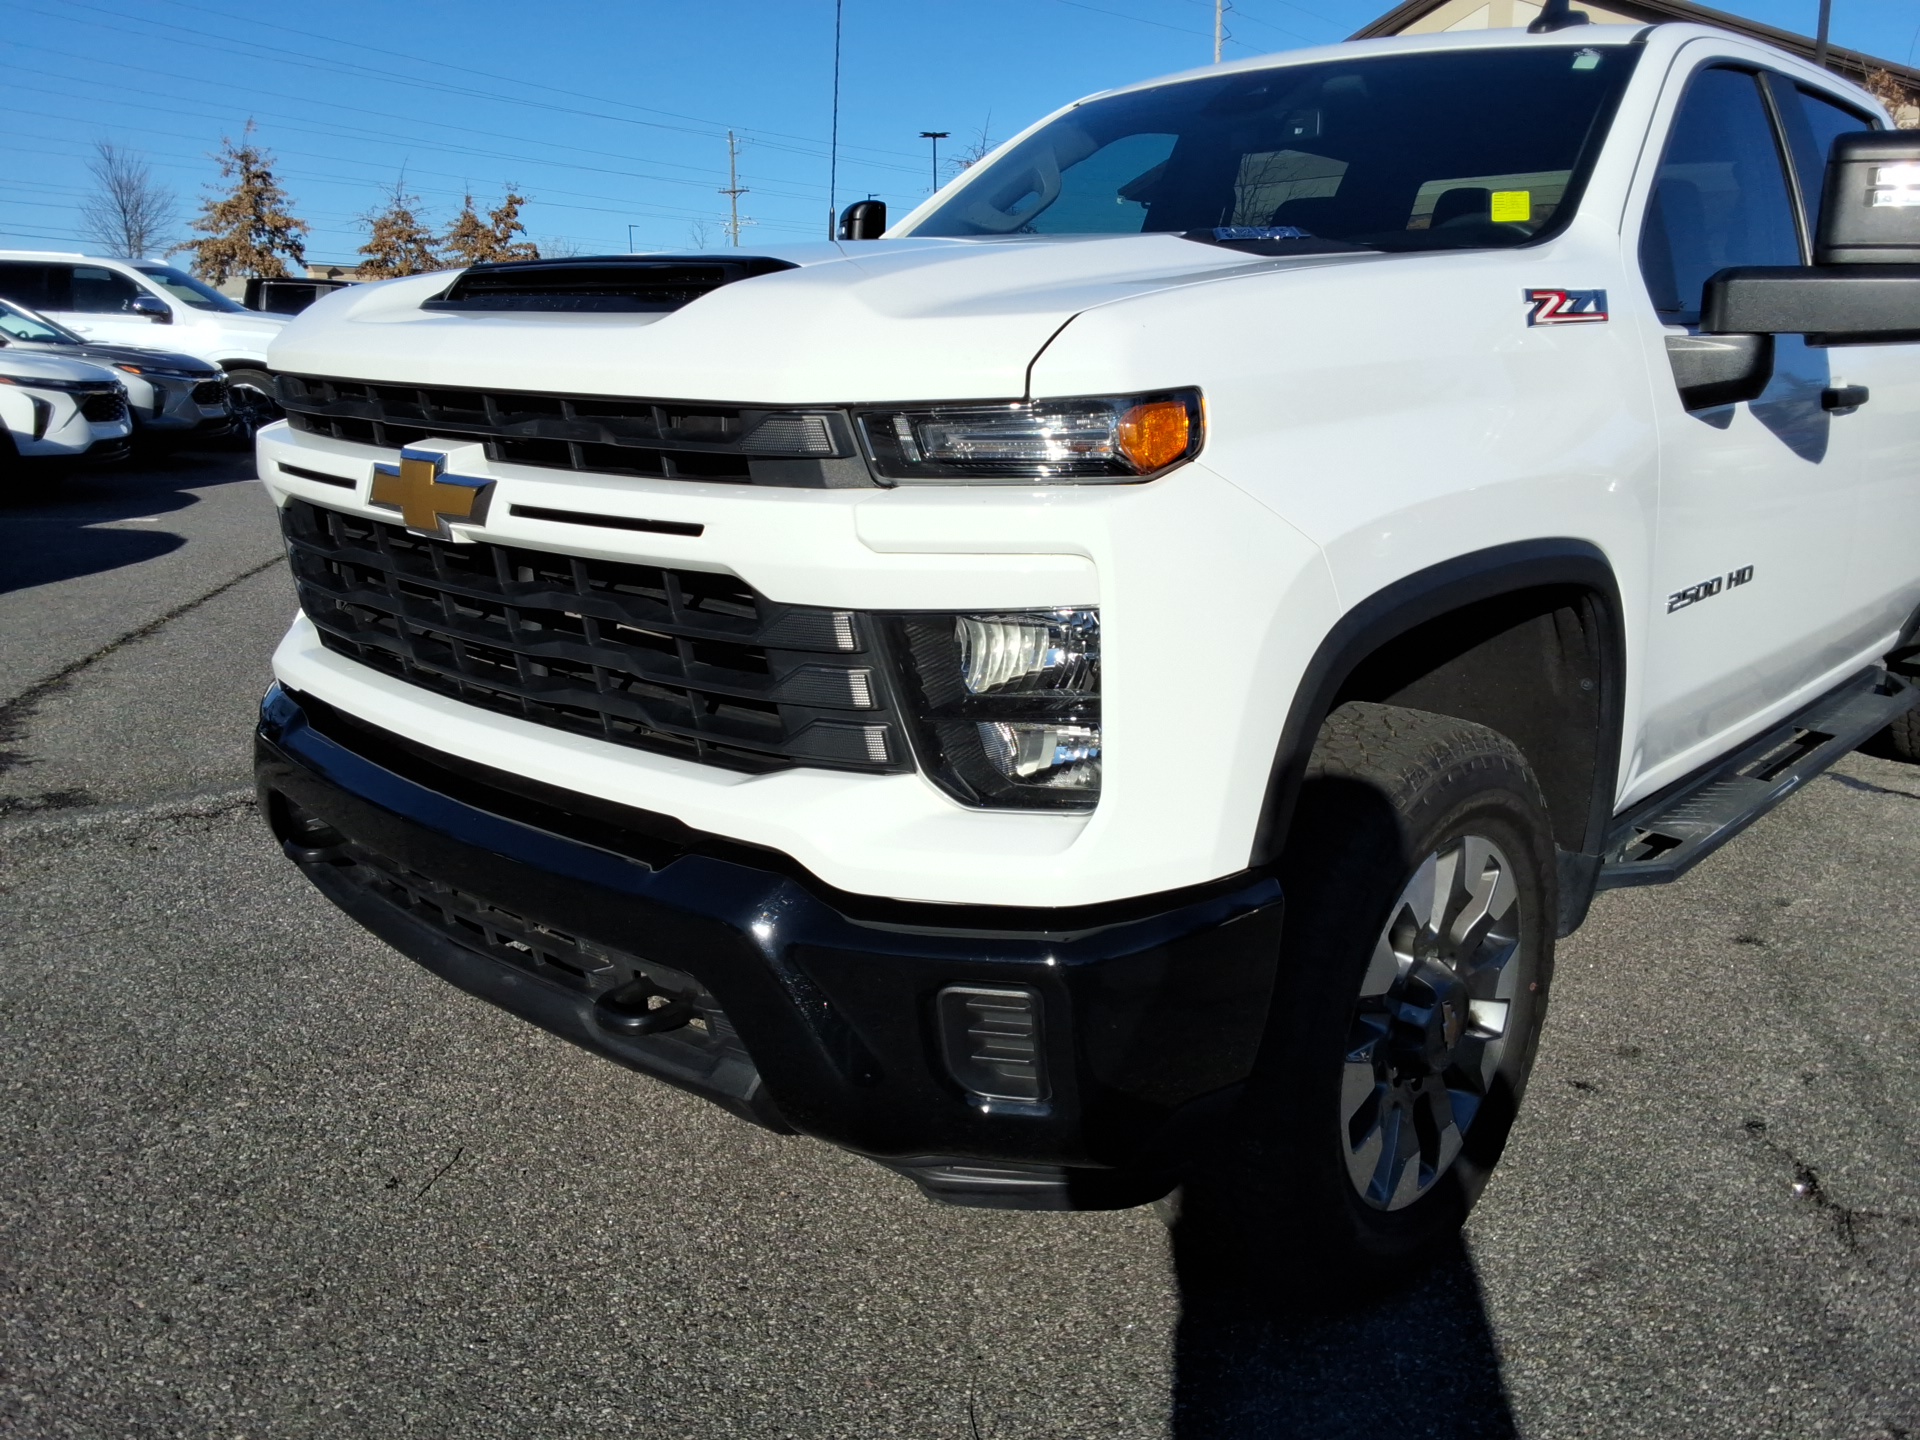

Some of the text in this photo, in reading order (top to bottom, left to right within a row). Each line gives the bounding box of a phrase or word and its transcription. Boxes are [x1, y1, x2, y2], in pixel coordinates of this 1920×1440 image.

[1523, 289, 1608, 327] Z71
[1666, 564, 1754, 614] 2500 HD
